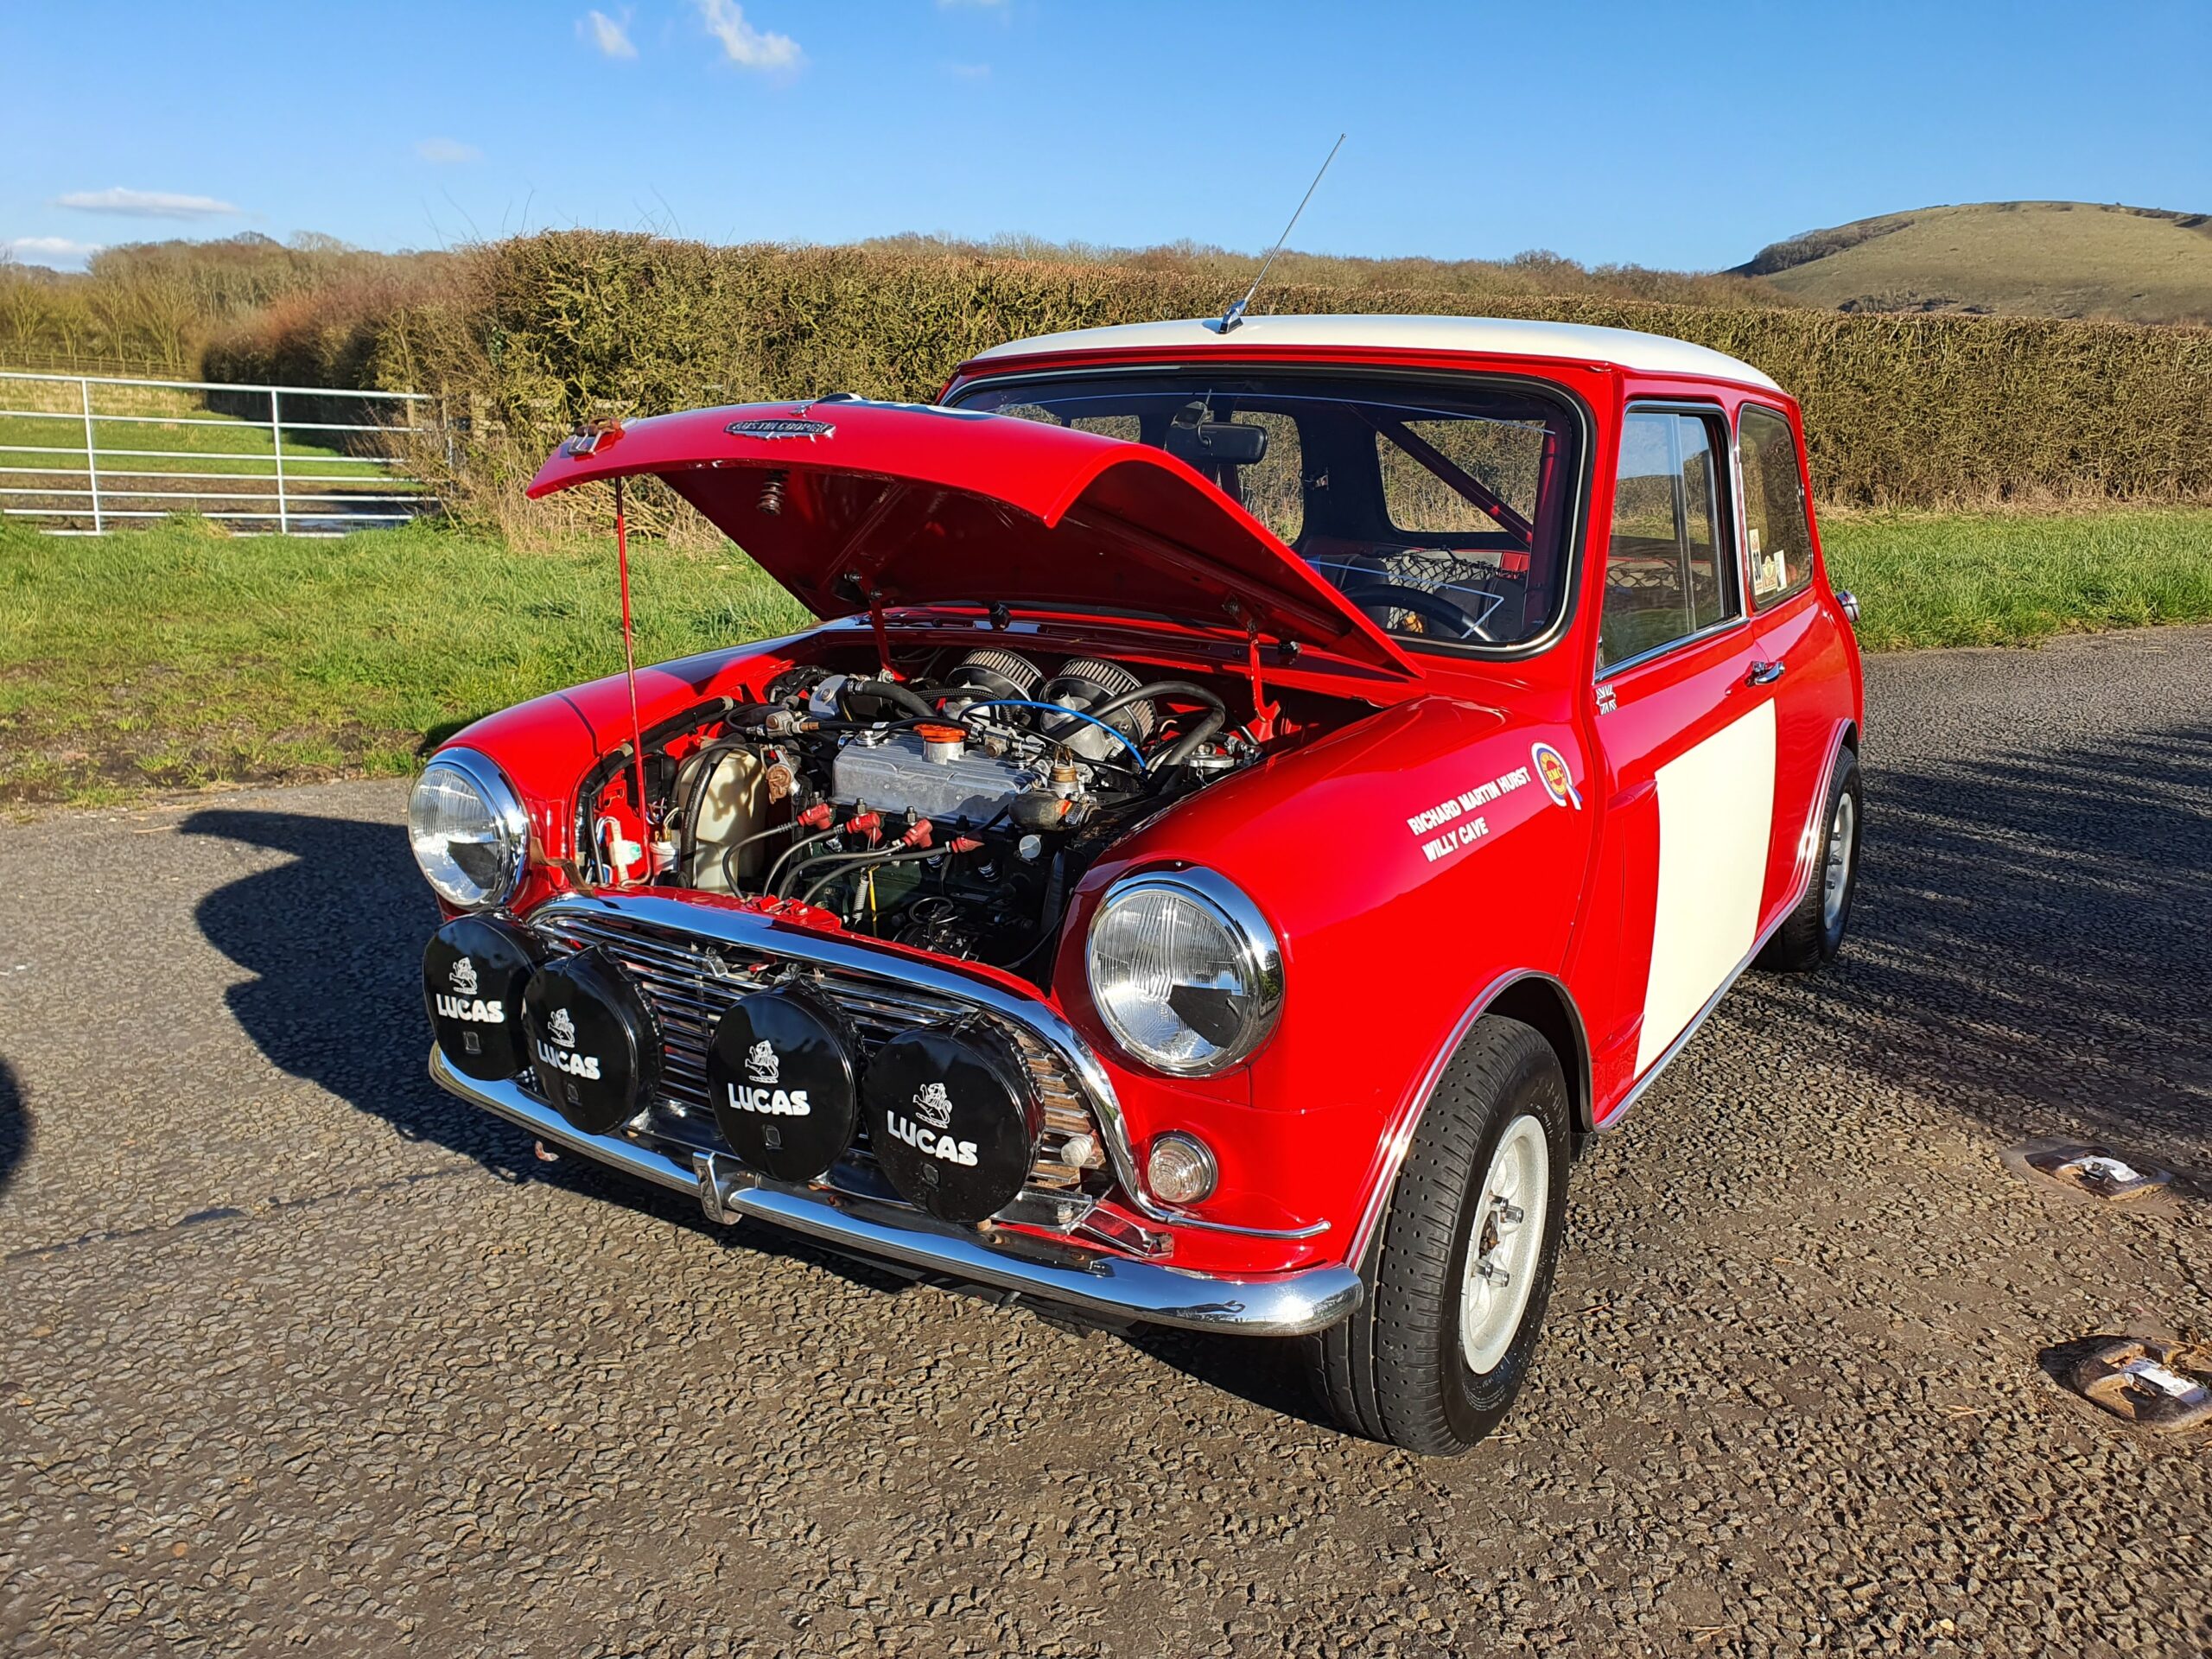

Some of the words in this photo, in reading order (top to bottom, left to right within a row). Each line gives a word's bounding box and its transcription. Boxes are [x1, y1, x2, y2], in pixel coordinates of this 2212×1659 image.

[733, 422, 779, 430] AUSTIN
[777, 423, 829, 432] COOPER
[1546, 766, 1563, 782] BMC
[1407, 799, 1462, 836] RICHARD
[1457, 781, 1503, 812] MARTIN
[1497, 766, 1531, 794] HURST
[1421, 830, 1459, 862] WILLY
[1458, 817, 1490, 845] CAVE
[435, 994, 505, 1023] LUCAS
[536, 1039, 601, 1080] LUCAS
[728, 1083, 811, 1116] LUCAS
[887, 1109, 979, 1166] LUCAS
